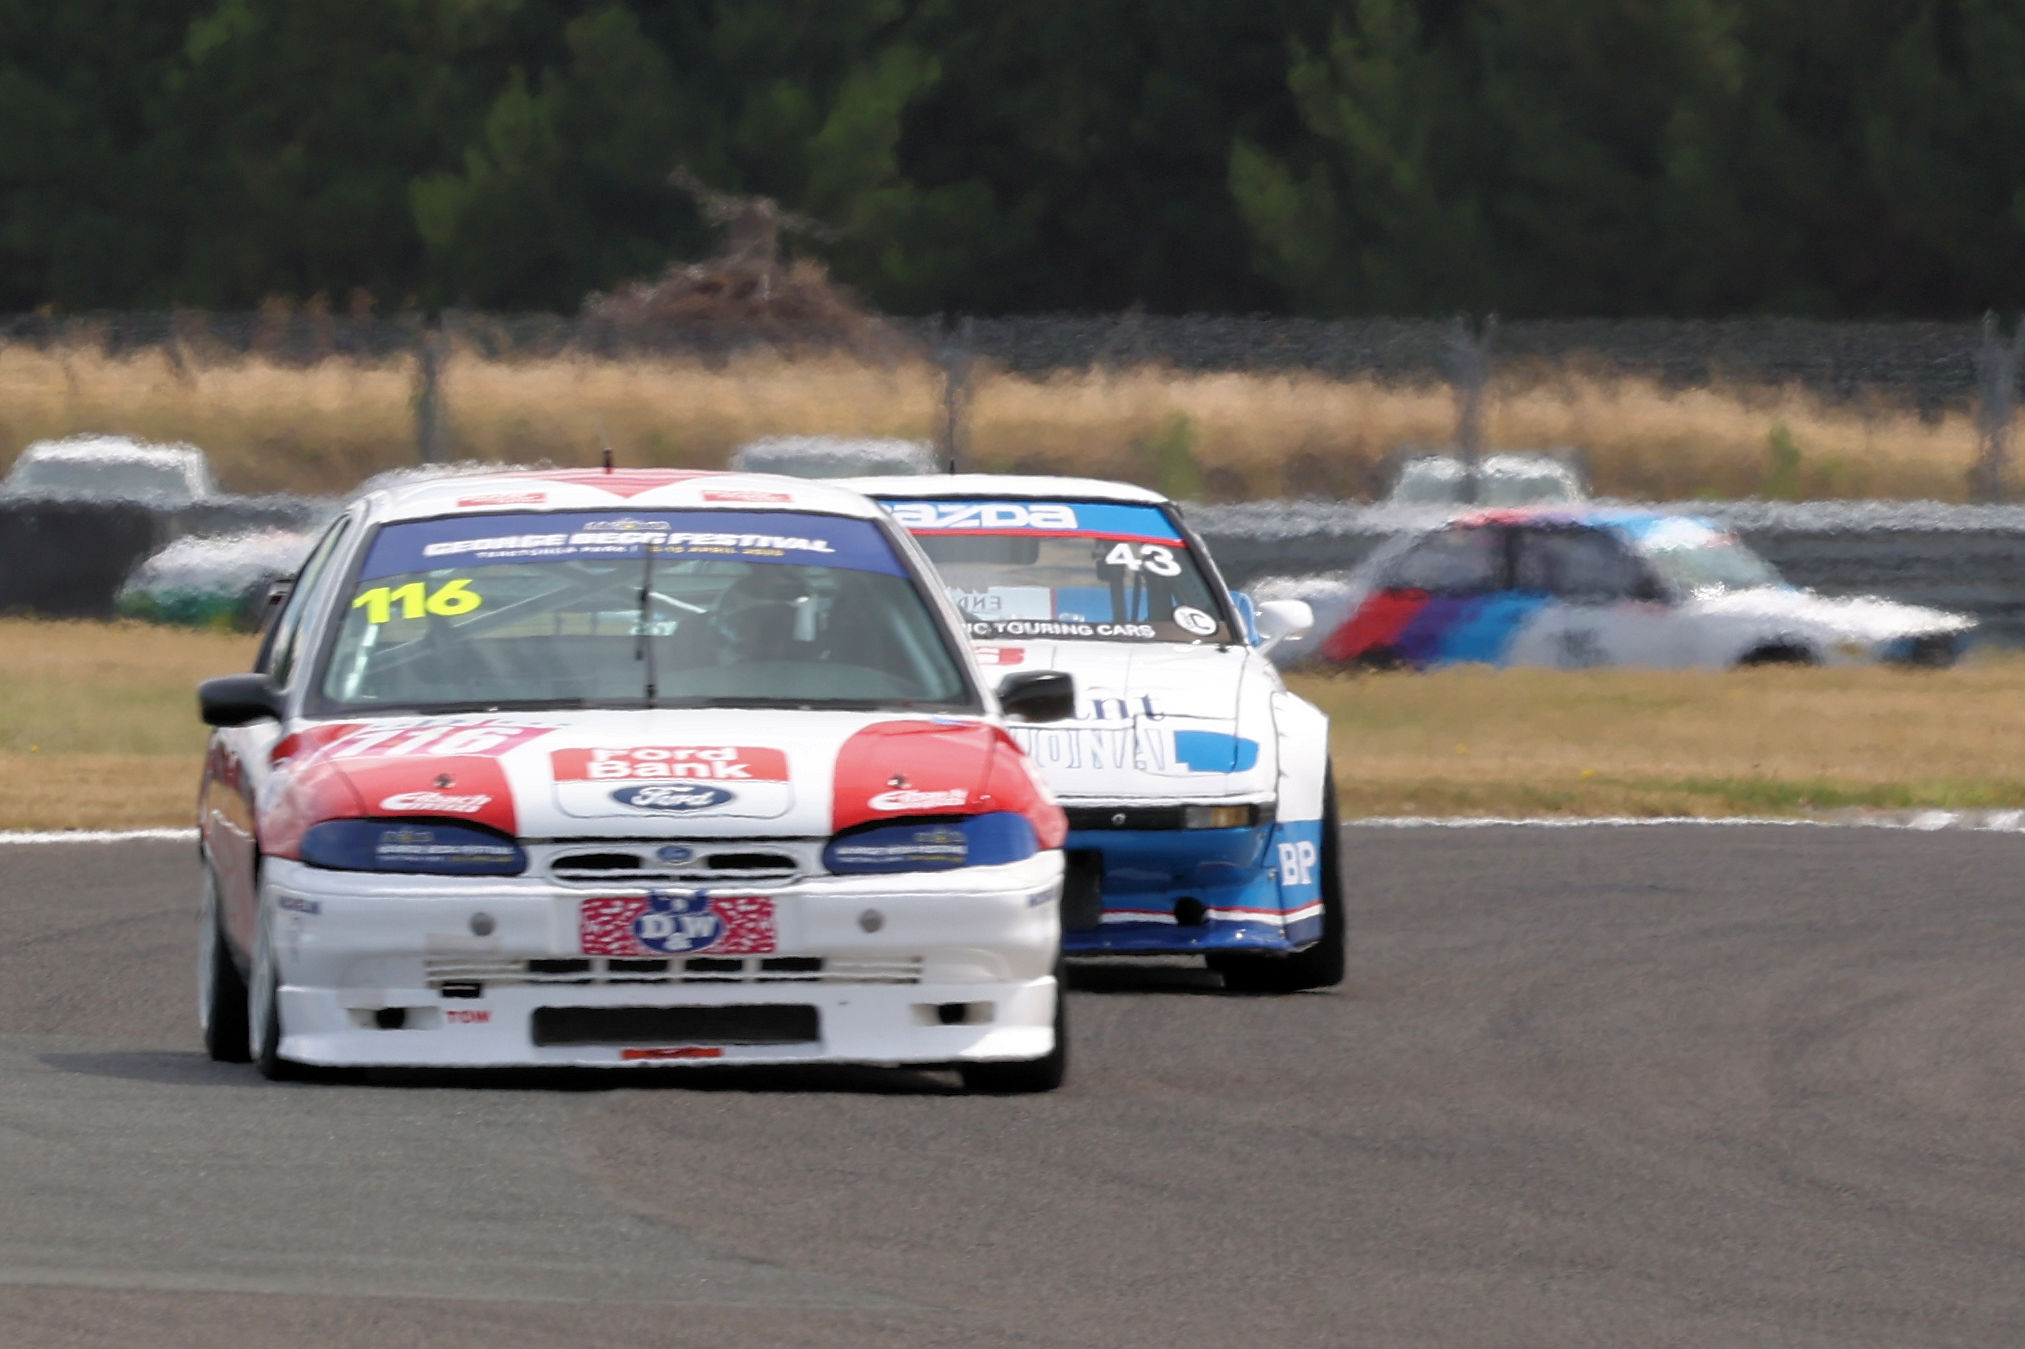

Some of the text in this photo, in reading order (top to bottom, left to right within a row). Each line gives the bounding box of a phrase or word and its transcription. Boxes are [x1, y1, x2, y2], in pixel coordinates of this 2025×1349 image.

[422, 534, 569, 557] GEORGE
[667, 532, 837, 553] FESTIVAL
[1105, 543, 1182, 577] 43
[352, 579, 483, 624] 116
[995, 621, 1093, 636] TOURING
[1096, 623, 1156, 638] CARS
[328, 726, 524, 758] 116
[594, 747, 738, 762] Ford
[588, 760, 752, 779] Bank
[630, 784, 716, 807] Ford
[1278, 841, 1317, 887] BP
